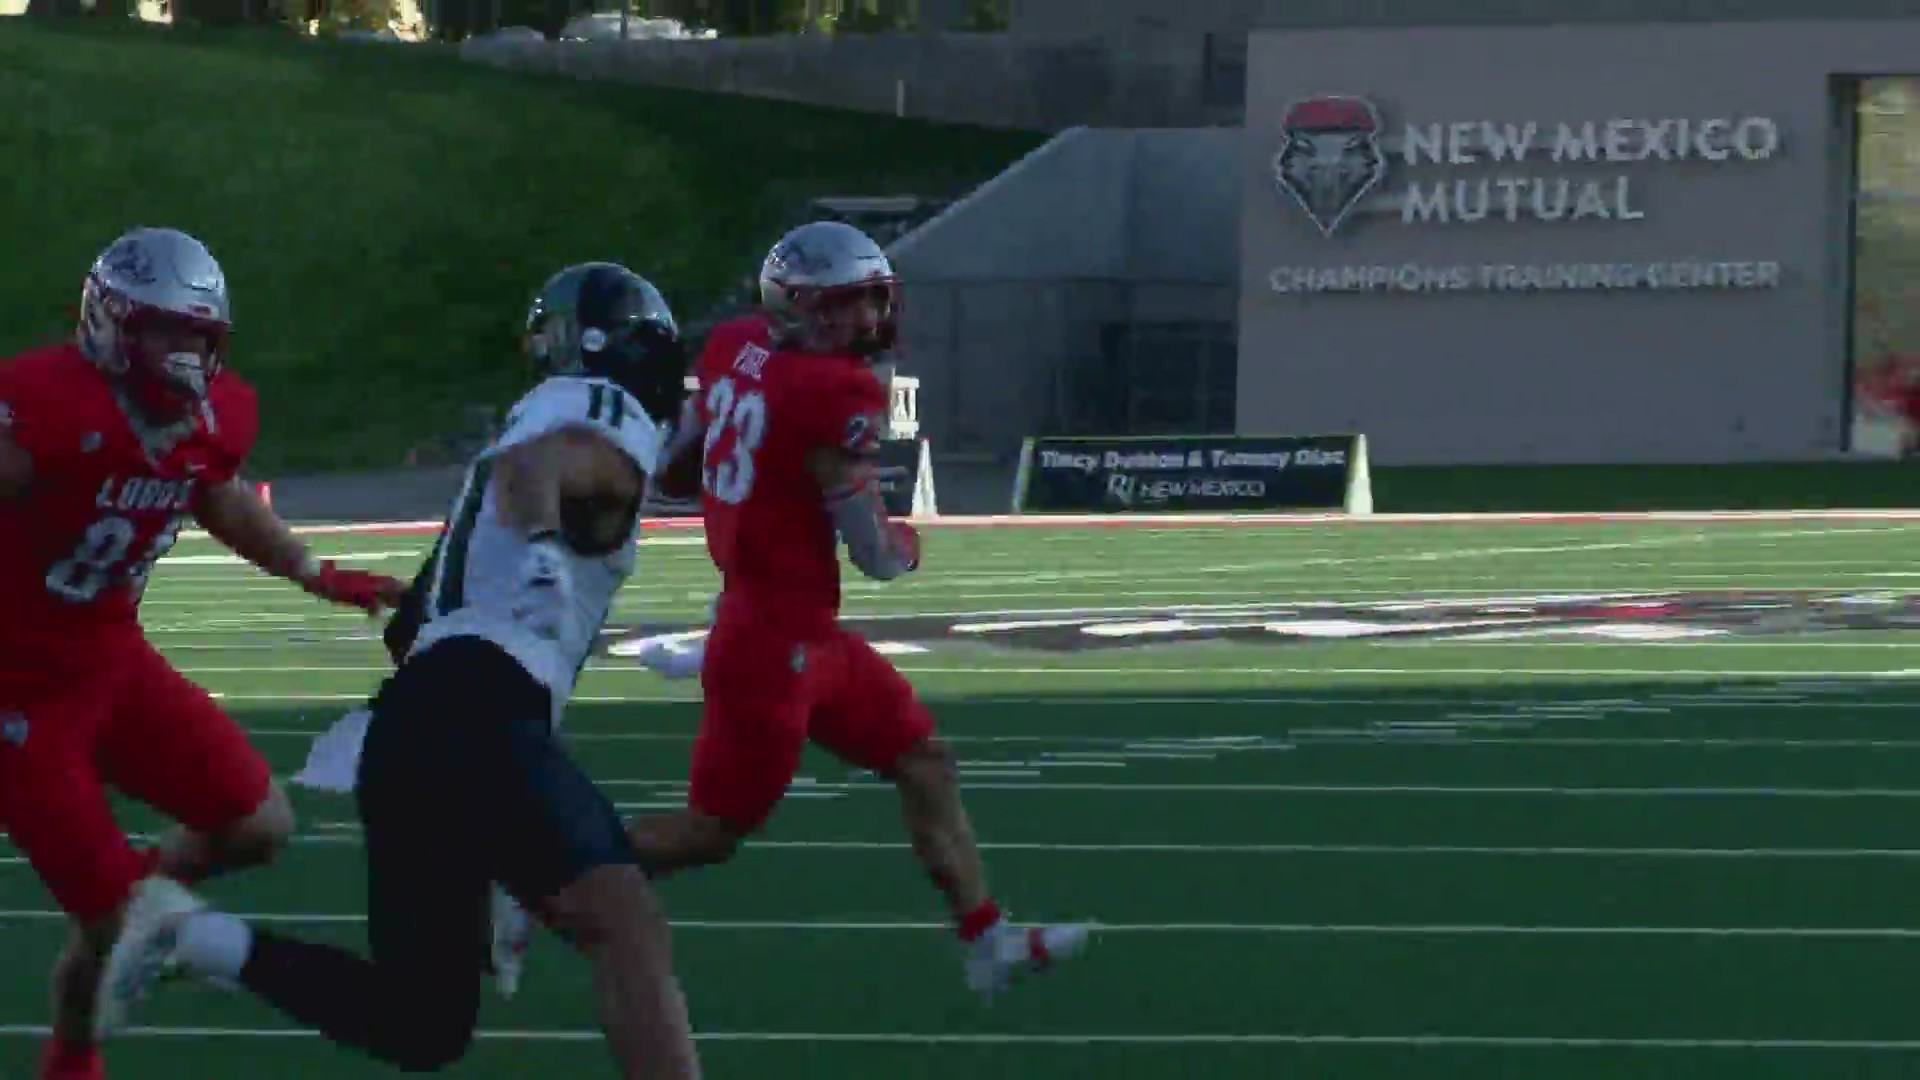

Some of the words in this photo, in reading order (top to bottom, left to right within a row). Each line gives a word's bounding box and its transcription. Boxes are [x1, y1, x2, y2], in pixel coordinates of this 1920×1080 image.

[1402, 121, 1537, 165] NEW
[1552, 117, 1777, 162] MEXICO
[1402, 175, 1644, 224] MUTUAL
[1268, 262, 1471, 292] CHAMPIONS
[1479, 262, 1637, 289] TRAINING
[1648, 261, 1780, 289] CENTER
[702, 376, 766, 504] 23
[1140, 480, 1185, 499] NEW
[1187, 479, 1266, 498] MEXICO
